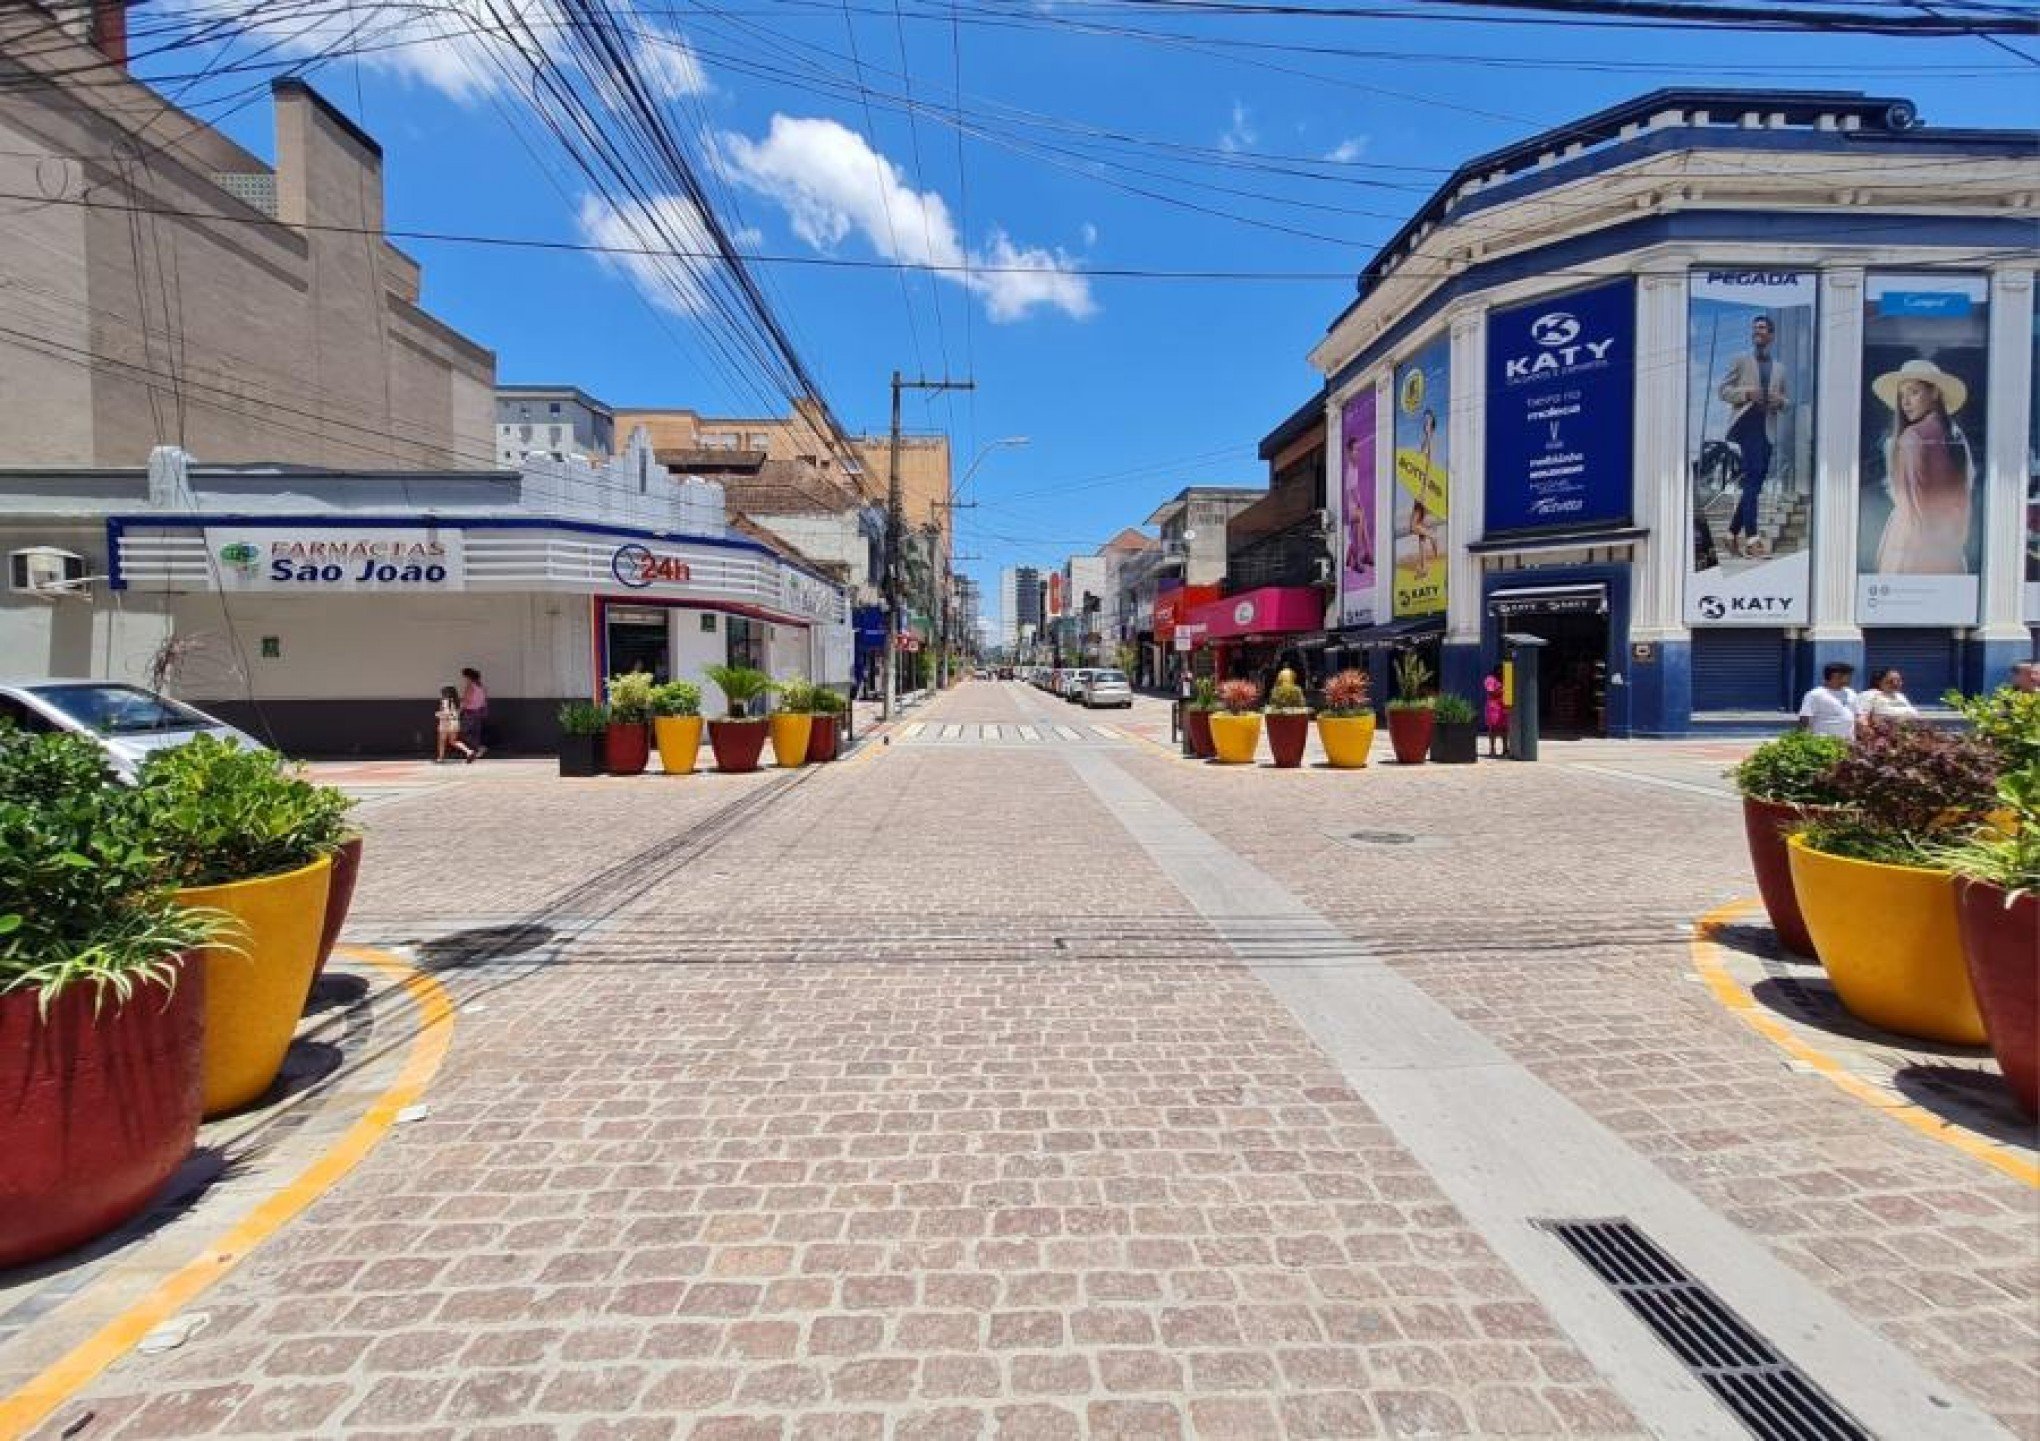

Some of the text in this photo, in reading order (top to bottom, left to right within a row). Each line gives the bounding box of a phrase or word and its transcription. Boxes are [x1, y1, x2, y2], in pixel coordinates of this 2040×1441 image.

[1505, 337, 1615, 378] KATY
[640, 553, 690, 581] 24h
[1730, 597, 1794, 611] KATY
